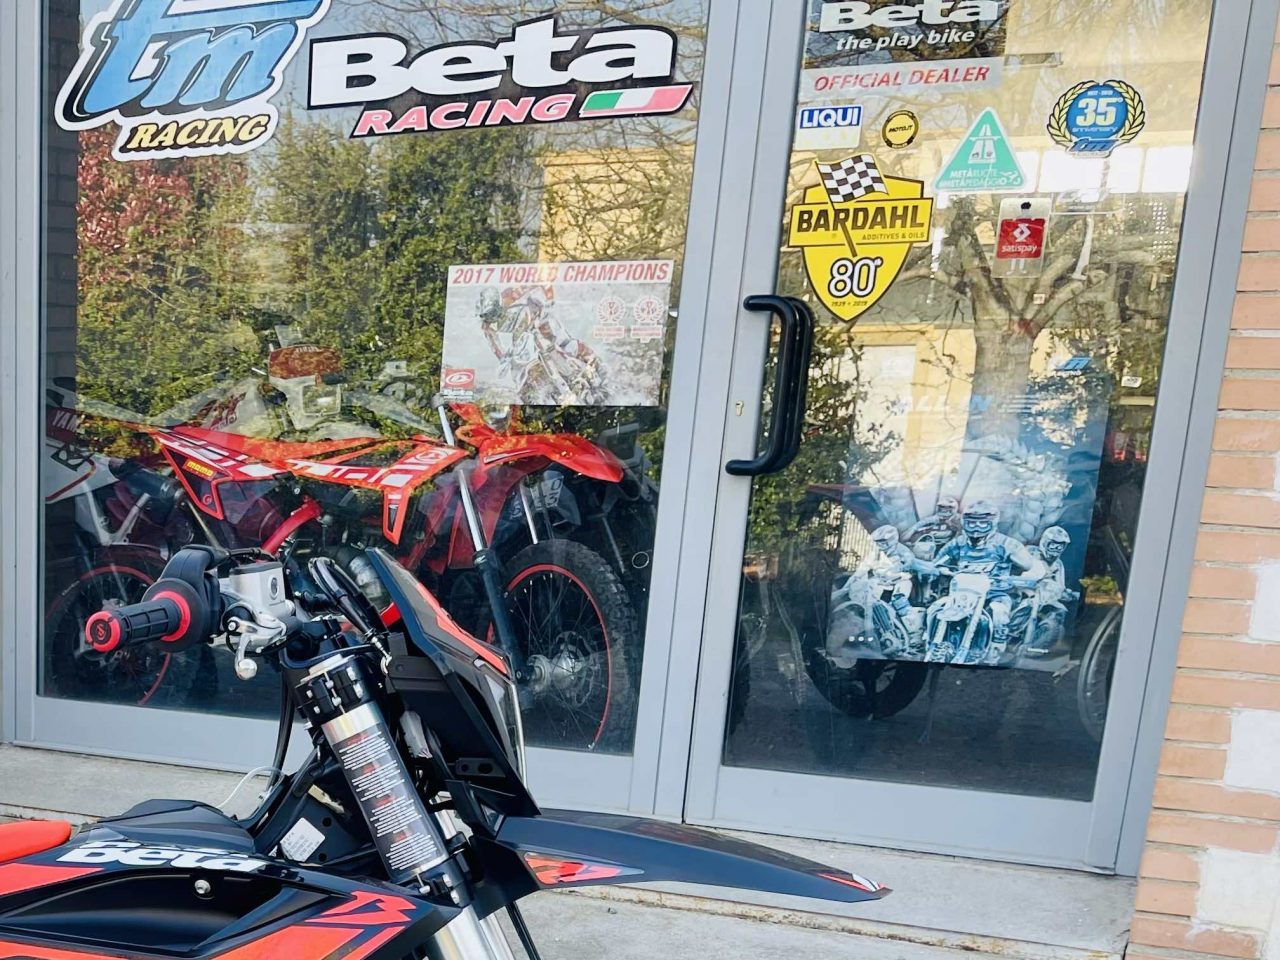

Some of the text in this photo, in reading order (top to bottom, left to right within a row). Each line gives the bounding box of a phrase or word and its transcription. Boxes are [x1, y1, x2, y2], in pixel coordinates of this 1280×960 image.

[819, 0, 999, 32] Beta
[836, 29, 975, 50] the play bike
[310, 18, 675, 106] Beta
[908, 66, 990, 84] DEALER
[352, 93, 576, 137] RACING
[802, 108, 860, 127] LIQUI
[126, 114, 271, 149] RACING
[797, 205, 925, 233] BARDAHL
[862, 233, 900, 241] ADDITIVES
[1002, 244, 1038, 254] satispay
[453, 263, 669, 285] 2017 WORLD CHAMPIONS
[56, 841, 268, 872] Beta
